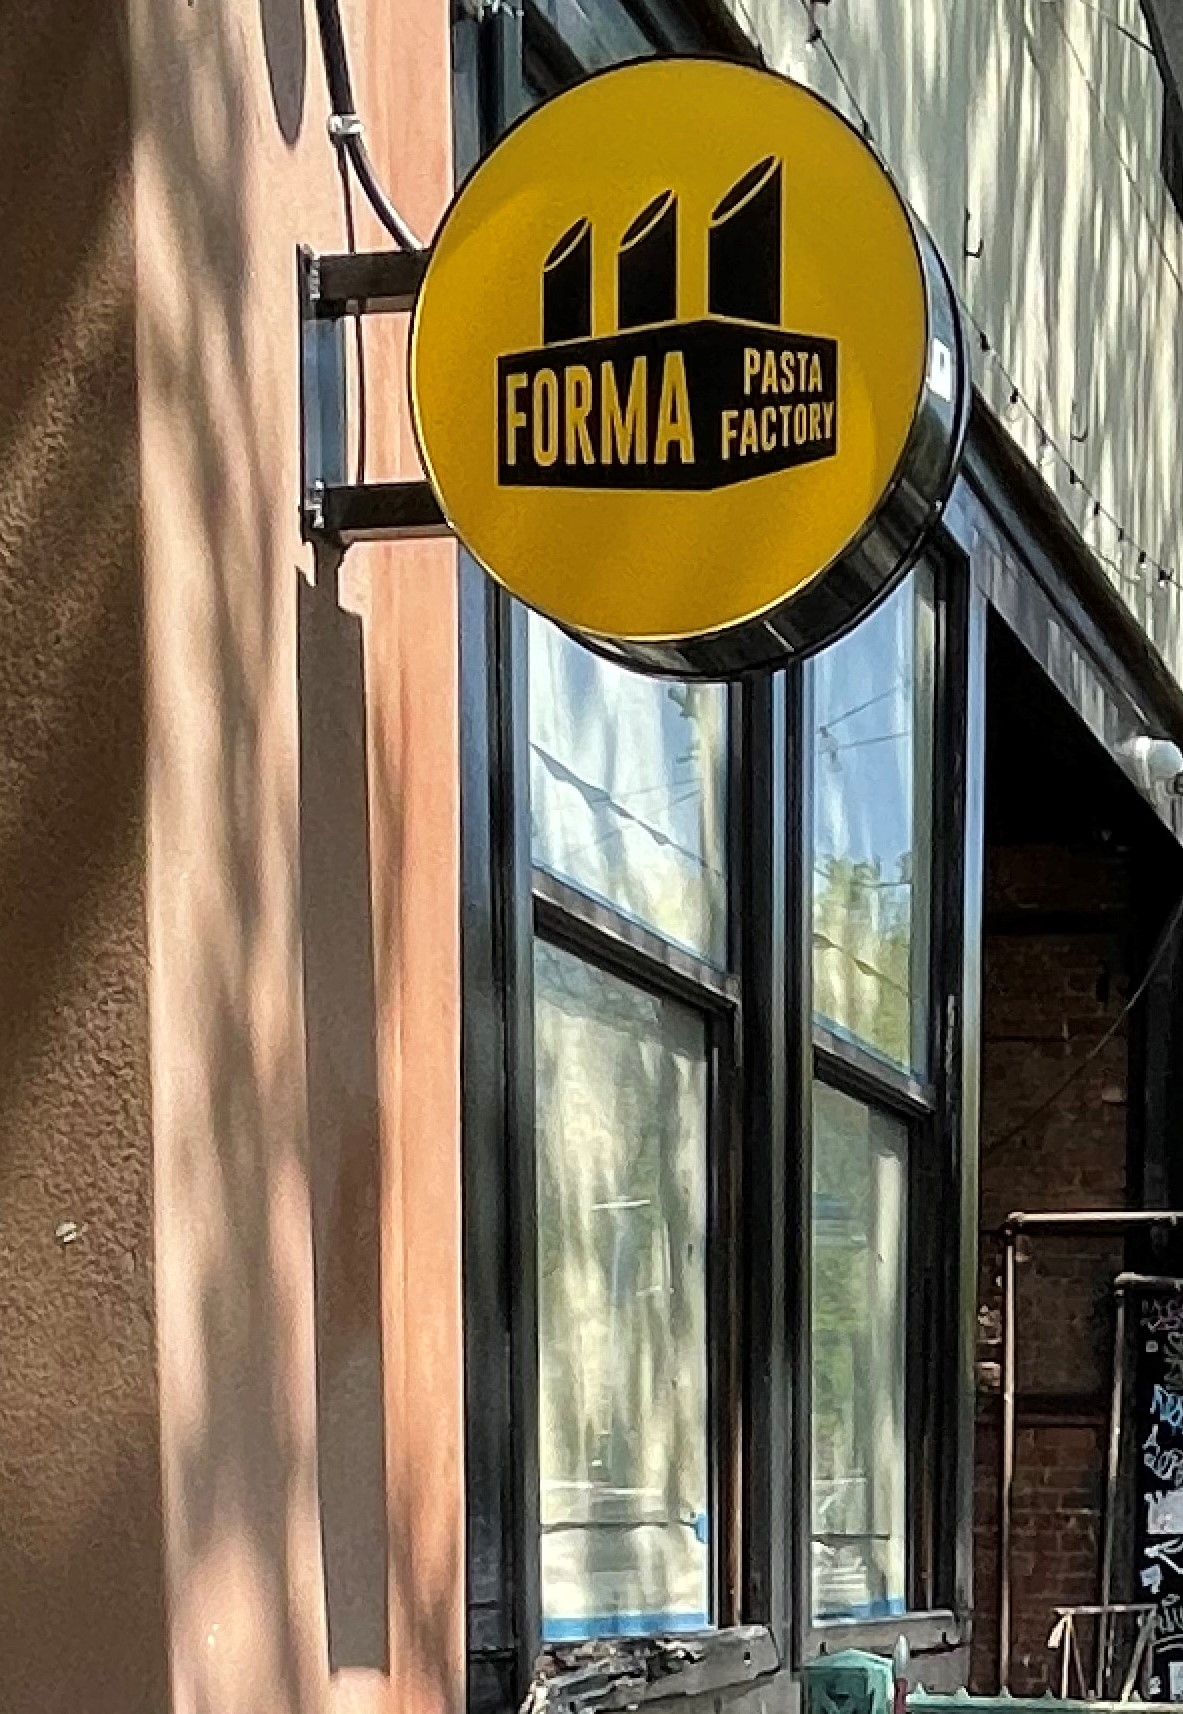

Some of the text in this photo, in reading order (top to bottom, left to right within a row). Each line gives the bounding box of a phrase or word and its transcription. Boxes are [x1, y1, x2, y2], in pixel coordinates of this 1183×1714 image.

[743, 347, 822, 394] PASTA
[506, 351, 695, 465] FORMA
[721, 402, 833, 460] FACTORY
